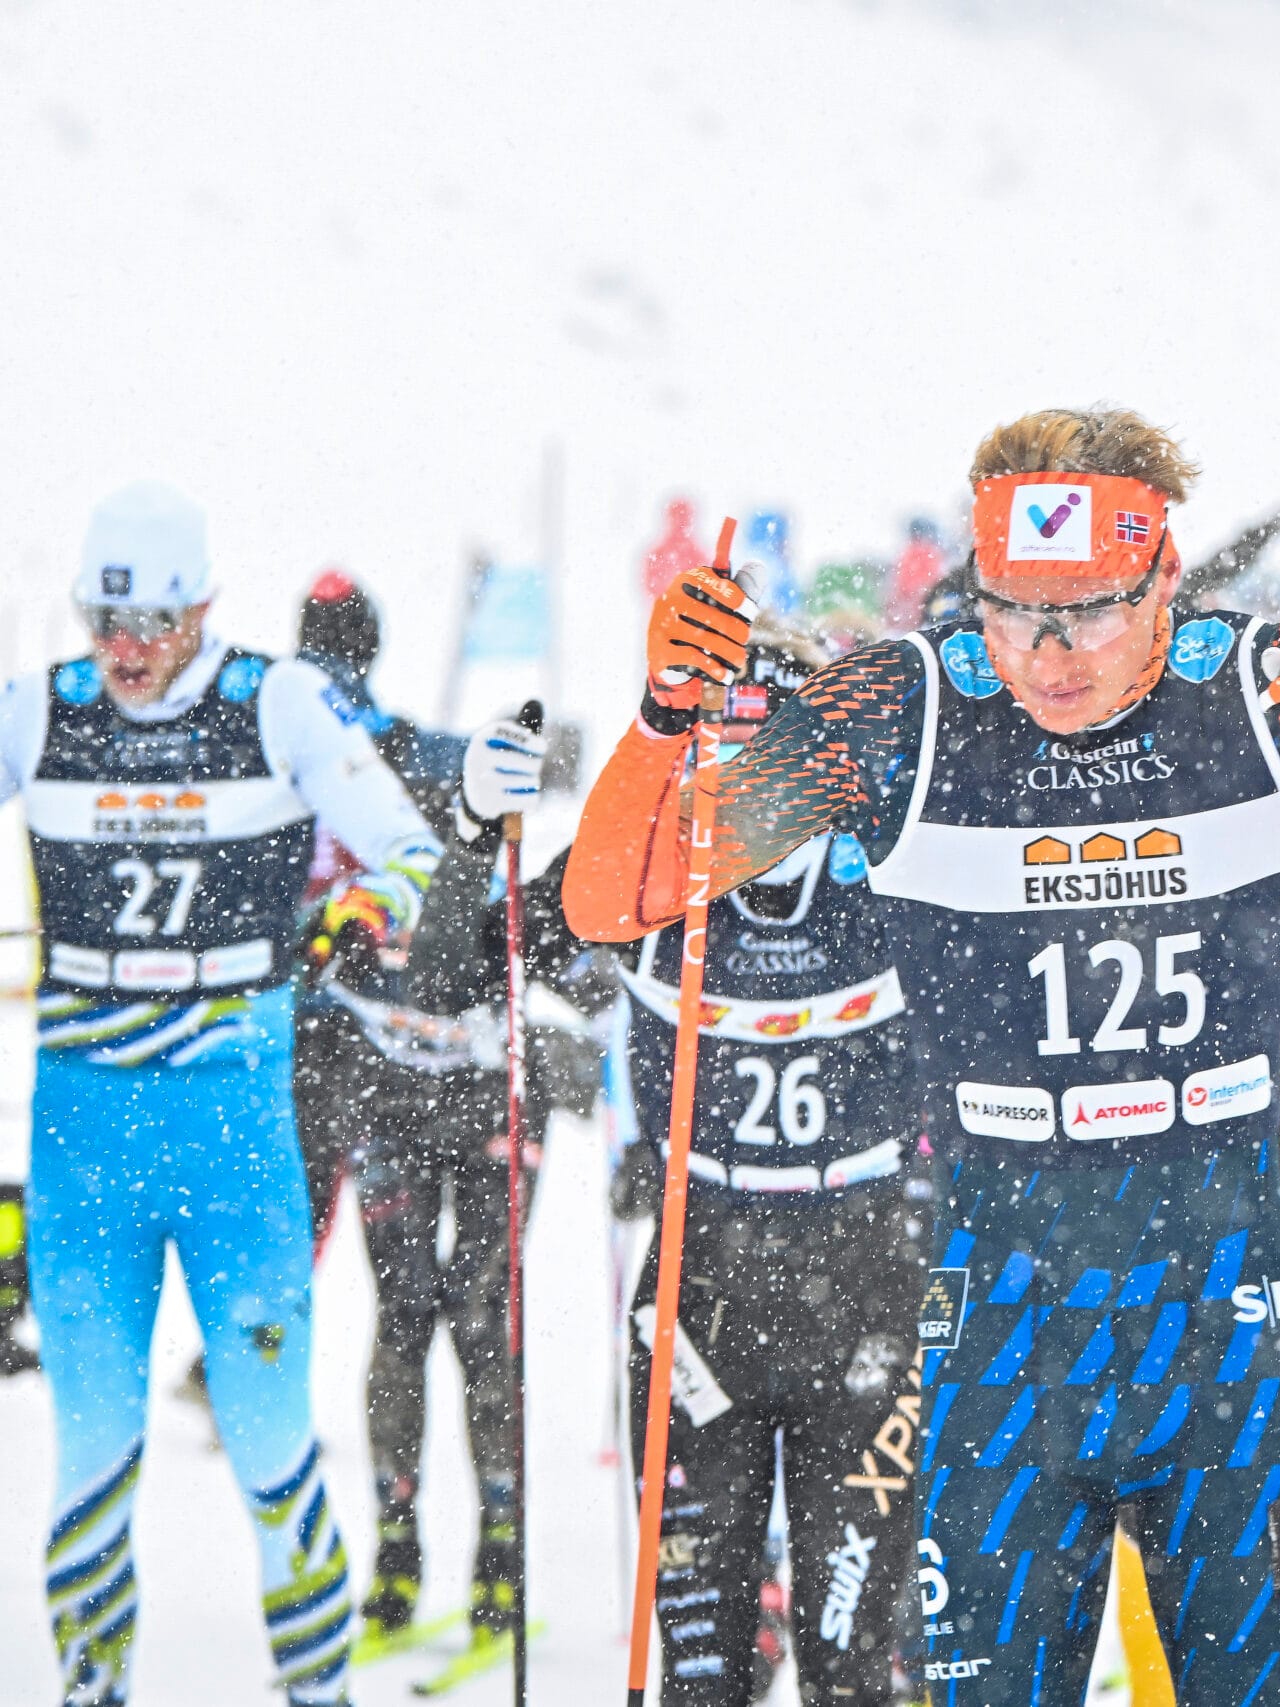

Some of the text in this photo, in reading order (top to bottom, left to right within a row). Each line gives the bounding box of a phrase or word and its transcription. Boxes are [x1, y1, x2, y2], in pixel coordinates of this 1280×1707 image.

[1051, 738, 1139, 764] Gastein
[1027, 755, 1172, 790] CLASSICS
[111, 858, 201, 936] 27
[1024, 867, 1188, 904] EKSJÖHUS
[1027, 931, 1206, 1056] 125
[733, 1055, 826, 1147] 26
[983, 1103, 1049, 1122] ALPRESOR
[1094, 1101, 1168, 1120] ATOMIC
